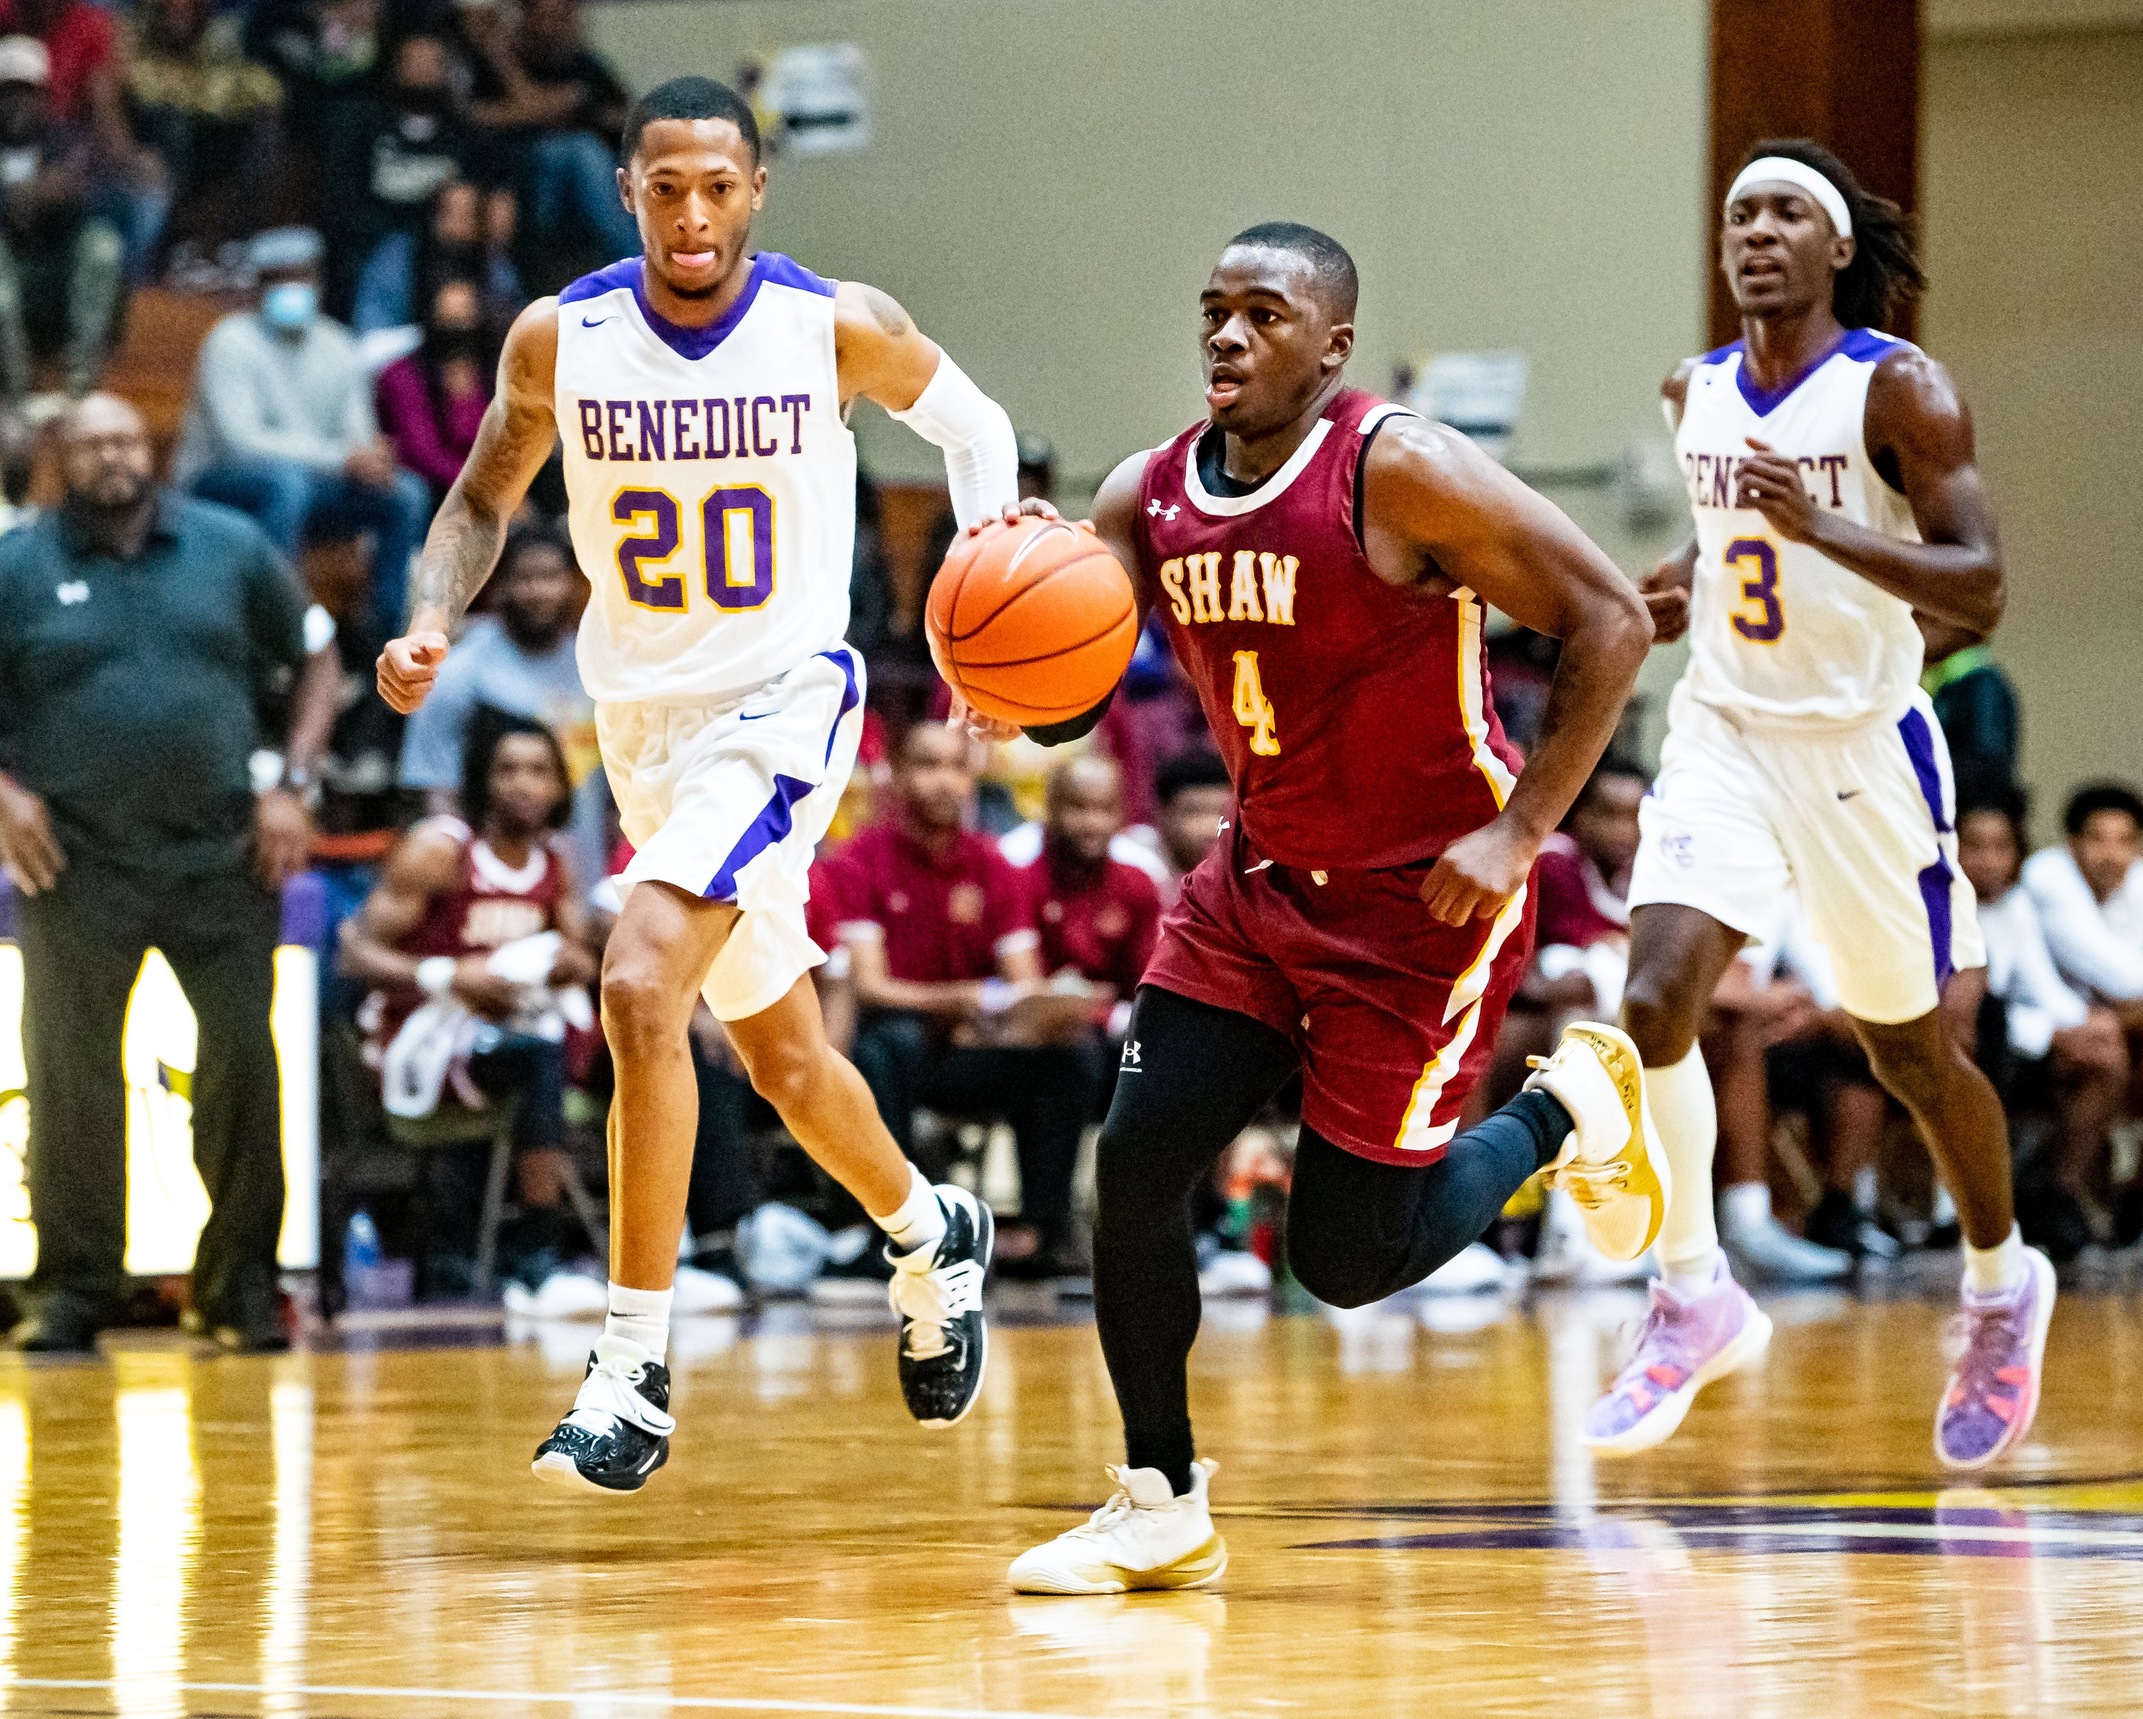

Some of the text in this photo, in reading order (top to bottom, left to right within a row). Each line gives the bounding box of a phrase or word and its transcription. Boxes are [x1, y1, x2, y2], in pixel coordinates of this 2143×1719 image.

[577, 394, 810, 461] BENEDICT
[610, 483, 777, 614] 20
[1160, 550, 1300, 626] SHAW
[1725, 536, 1787, 645] 3
[1232, 650, 1282, 756] 4
